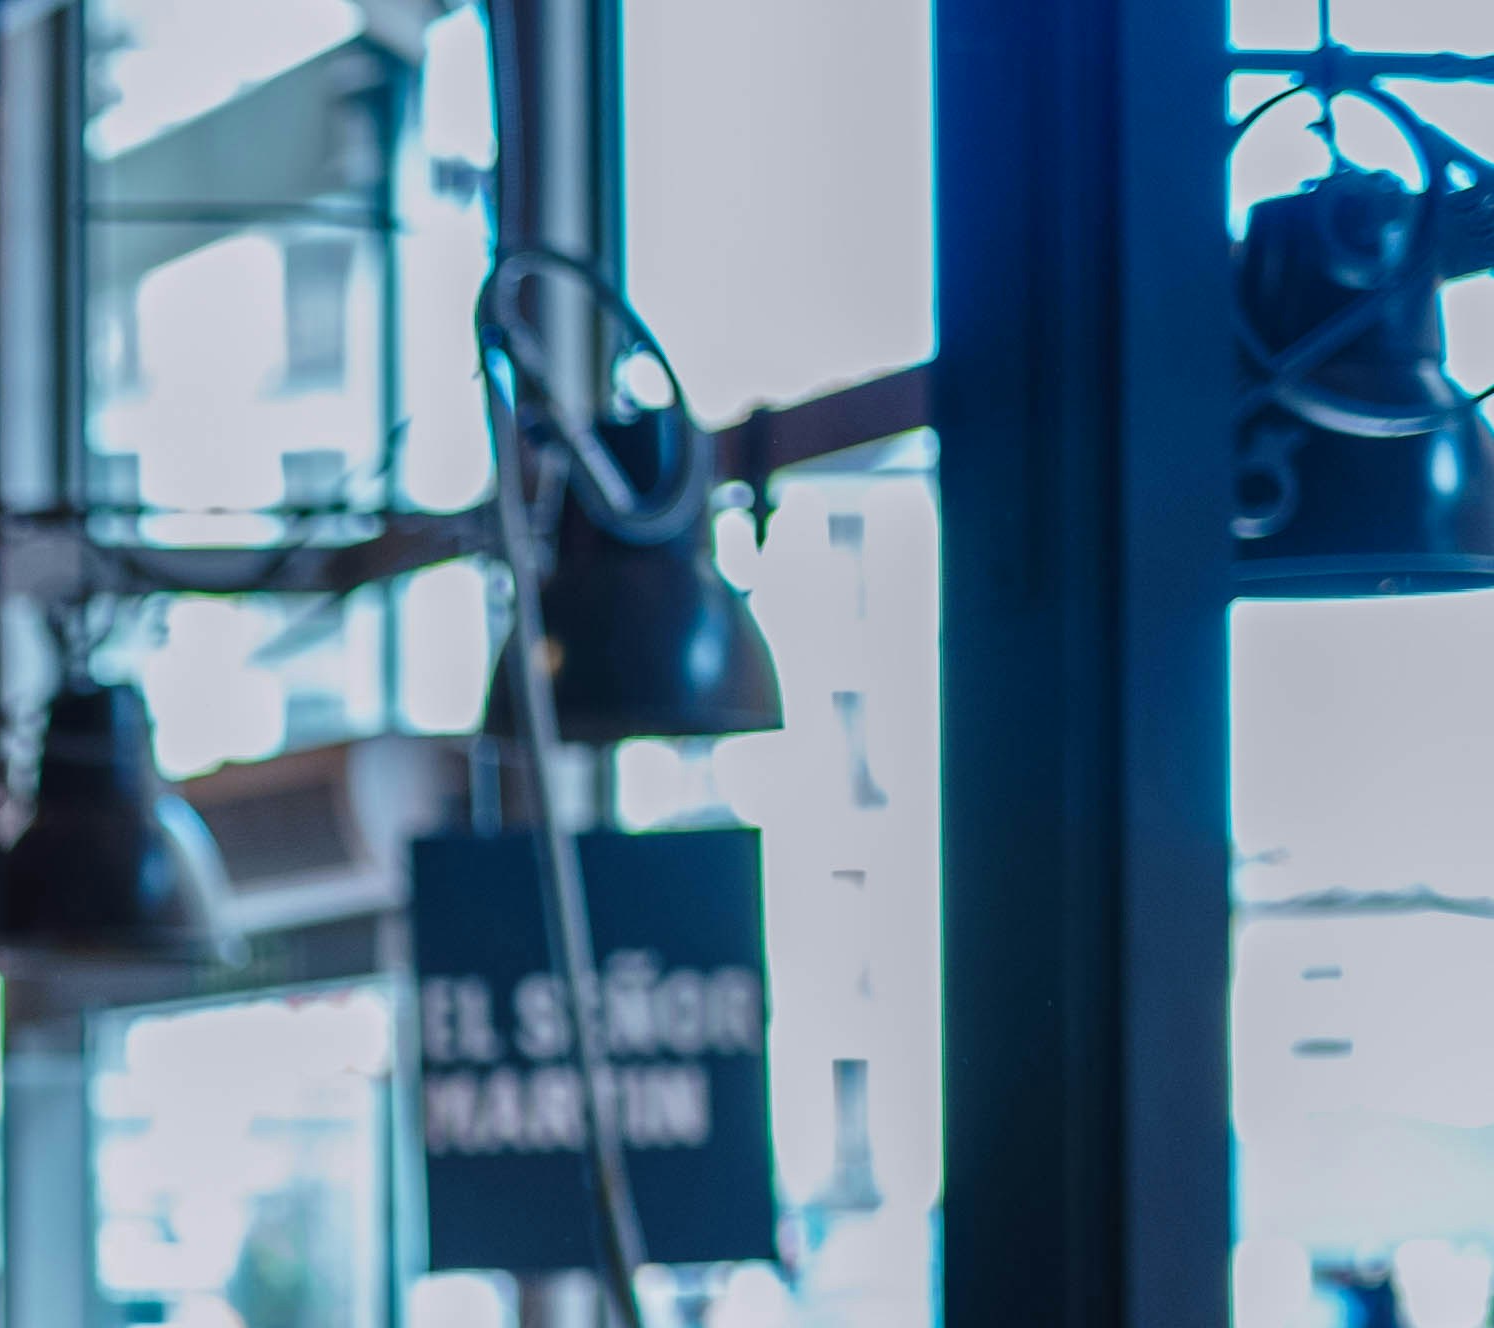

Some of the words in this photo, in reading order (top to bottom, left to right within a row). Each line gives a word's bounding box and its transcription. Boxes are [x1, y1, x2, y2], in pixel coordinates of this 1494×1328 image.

[422, 973, 502, 1062] EL
[514, 948, 764, 1058] SÑOR
[425, 1063, 710, 1158] MARIN
